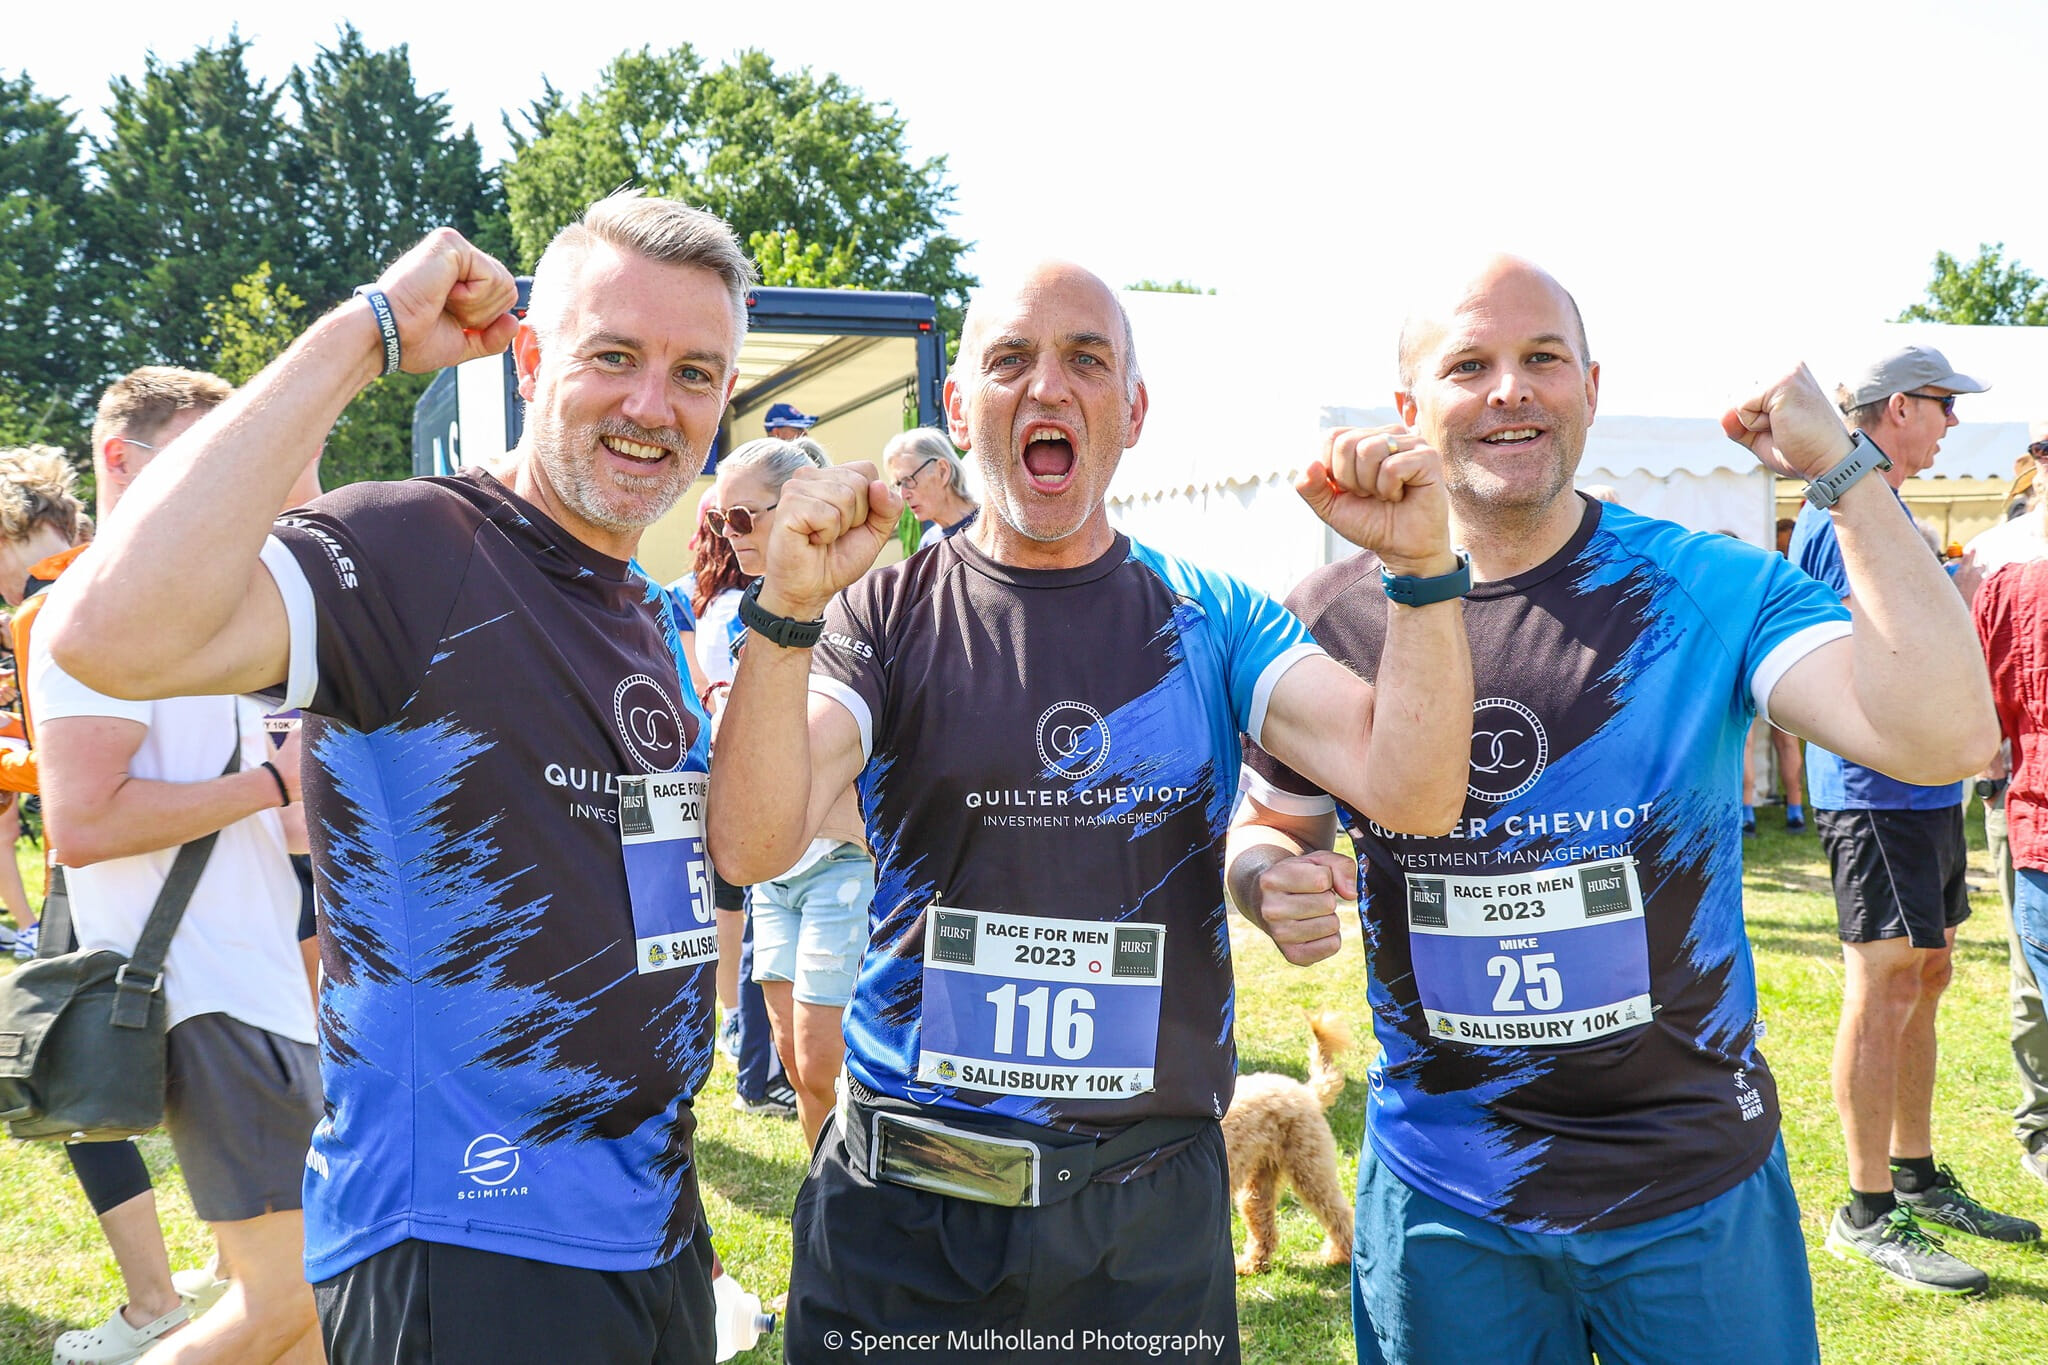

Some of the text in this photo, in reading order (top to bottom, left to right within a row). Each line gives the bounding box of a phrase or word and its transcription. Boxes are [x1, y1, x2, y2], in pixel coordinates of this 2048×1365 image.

[371, 293, 397, 338] BEATING
[828, 632, 874, 659] GILES
[273, 721, 290, 730] 10K
[652, 783, 686, 799] RACE
[688, 782, 700, 796] FO
[965, 786, 1188, 809] QUILTER CHEVIOT
[983, 811, 1169, 827] INVESTMENT MANAGEMENT
[1504, 802, 1653, 837] CHEVIOT
[1497, 841, 1634, 866] MANAGEMENT
[1453, 876, 1574, 899] RACE FOR MEN
[1586, 876, 1622, 893] HURST
[1414, 891, 1442, 904] HURST
[1482, 899, 1547, 922] 2023
[939, 925, 972, 940] HURST
[985, 922, 1109, 945] RACE FOR MEN
[1499, 937, 1540, 950] MIKE
[1014, 944, 1076, 967] 2023
[1120, 940, 1153, 954] HURST
[1486, 952, 1564, 1012] 25
[985, 983, 1097, 1061] 116
[1459, 1018, 1575, 1040] SALISBURY
[1582, 1009, 1620, 1033] 10K
[961, 1065, 1080, 1093] SALISBURY
[1085, 1075, 1124, 1093] 10K
[1736, 1088, 1761, 1106] RACE
[1742, 1103, 1765, 1122] MEN
[457, 1186, 529, 1200] SCIMITAR
